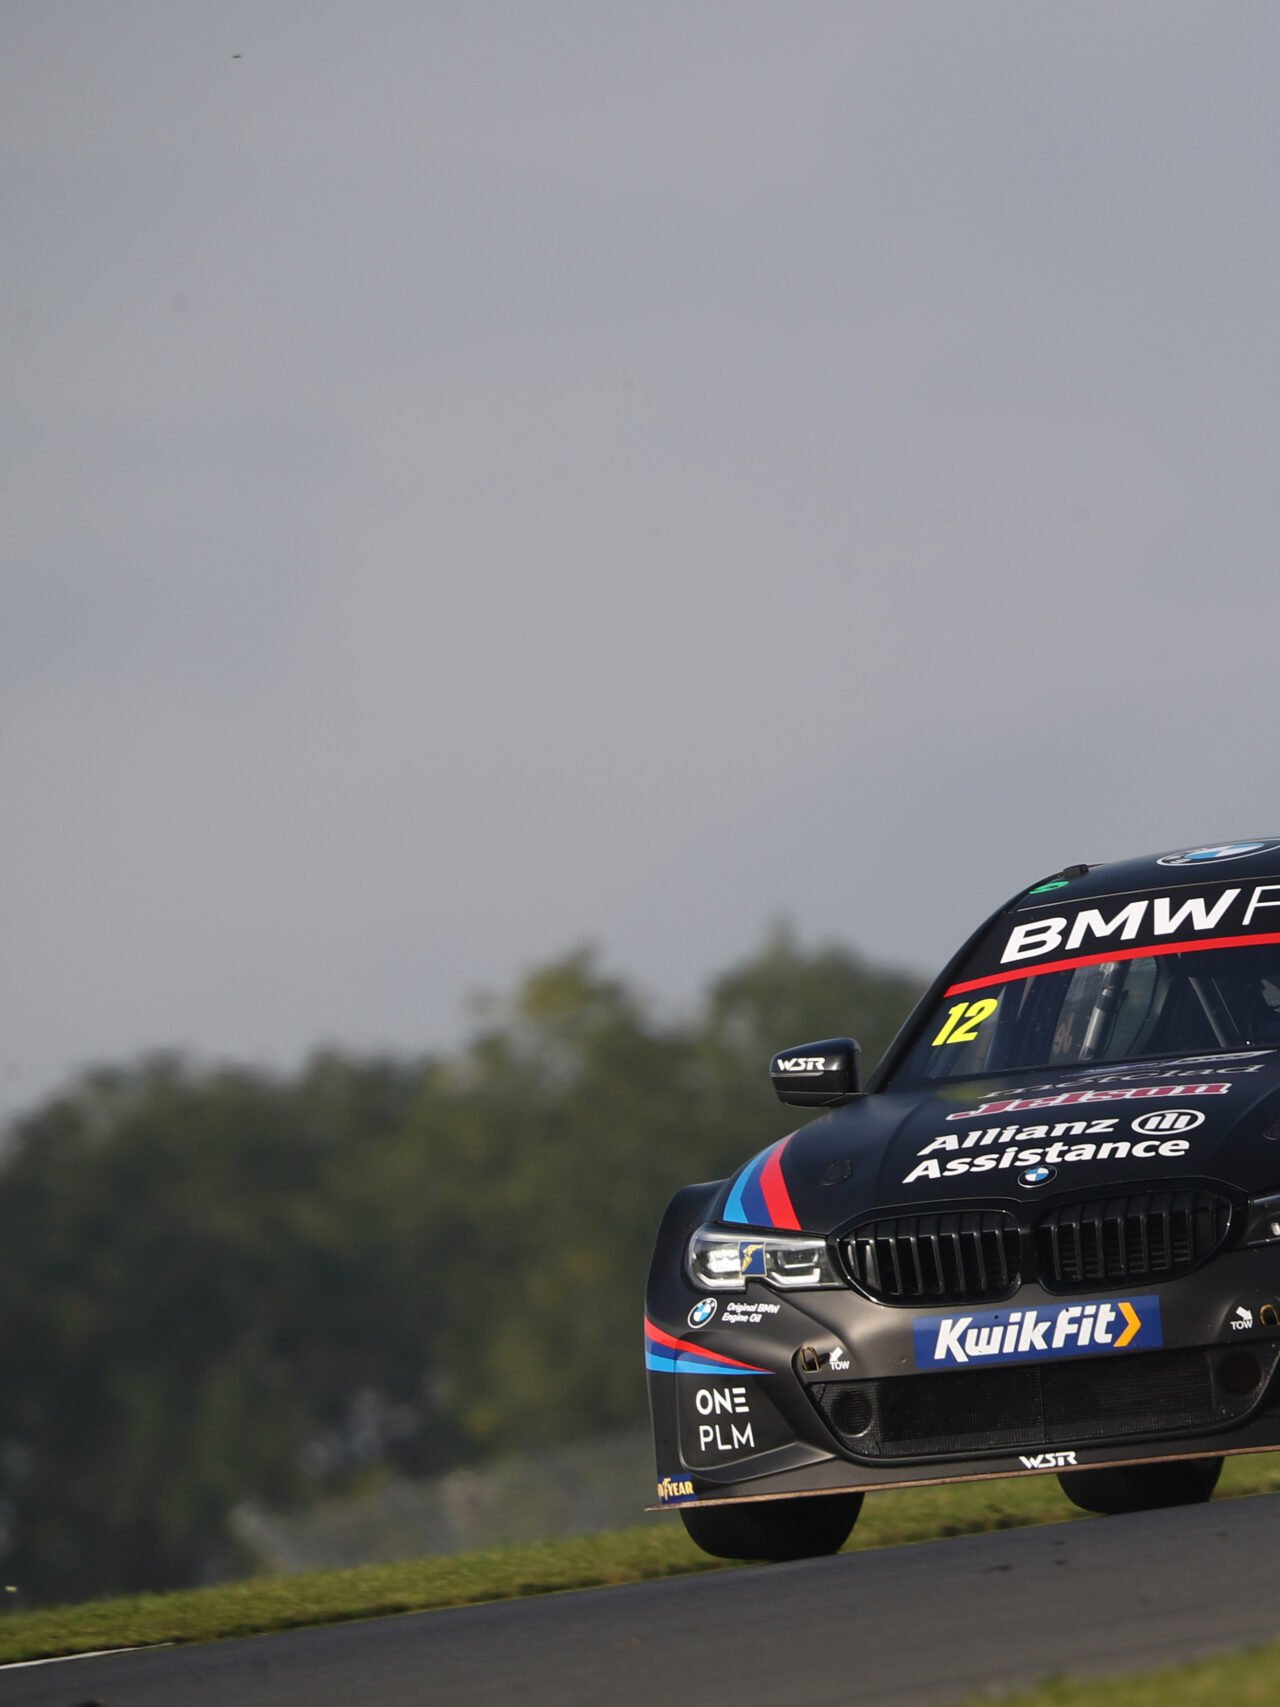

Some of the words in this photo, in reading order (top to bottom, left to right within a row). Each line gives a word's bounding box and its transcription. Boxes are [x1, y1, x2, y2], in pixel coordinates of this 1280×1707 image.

[932, 998, 998, 1046] 12
[777, 1057, 826, 1072] WSR
[917, 1118, 1120, 1156] Allianz
[902, 1140, 1190, 1184] Assistance
[1230, 1319, 1253, 1330] TOW
[830, 1360, 850, 1371] TOW
[695, 1387, 750, 1415] ONE
[699, 1422, 755, 1451] PLM
[1019, 1451, 1077, 1469] WSR
